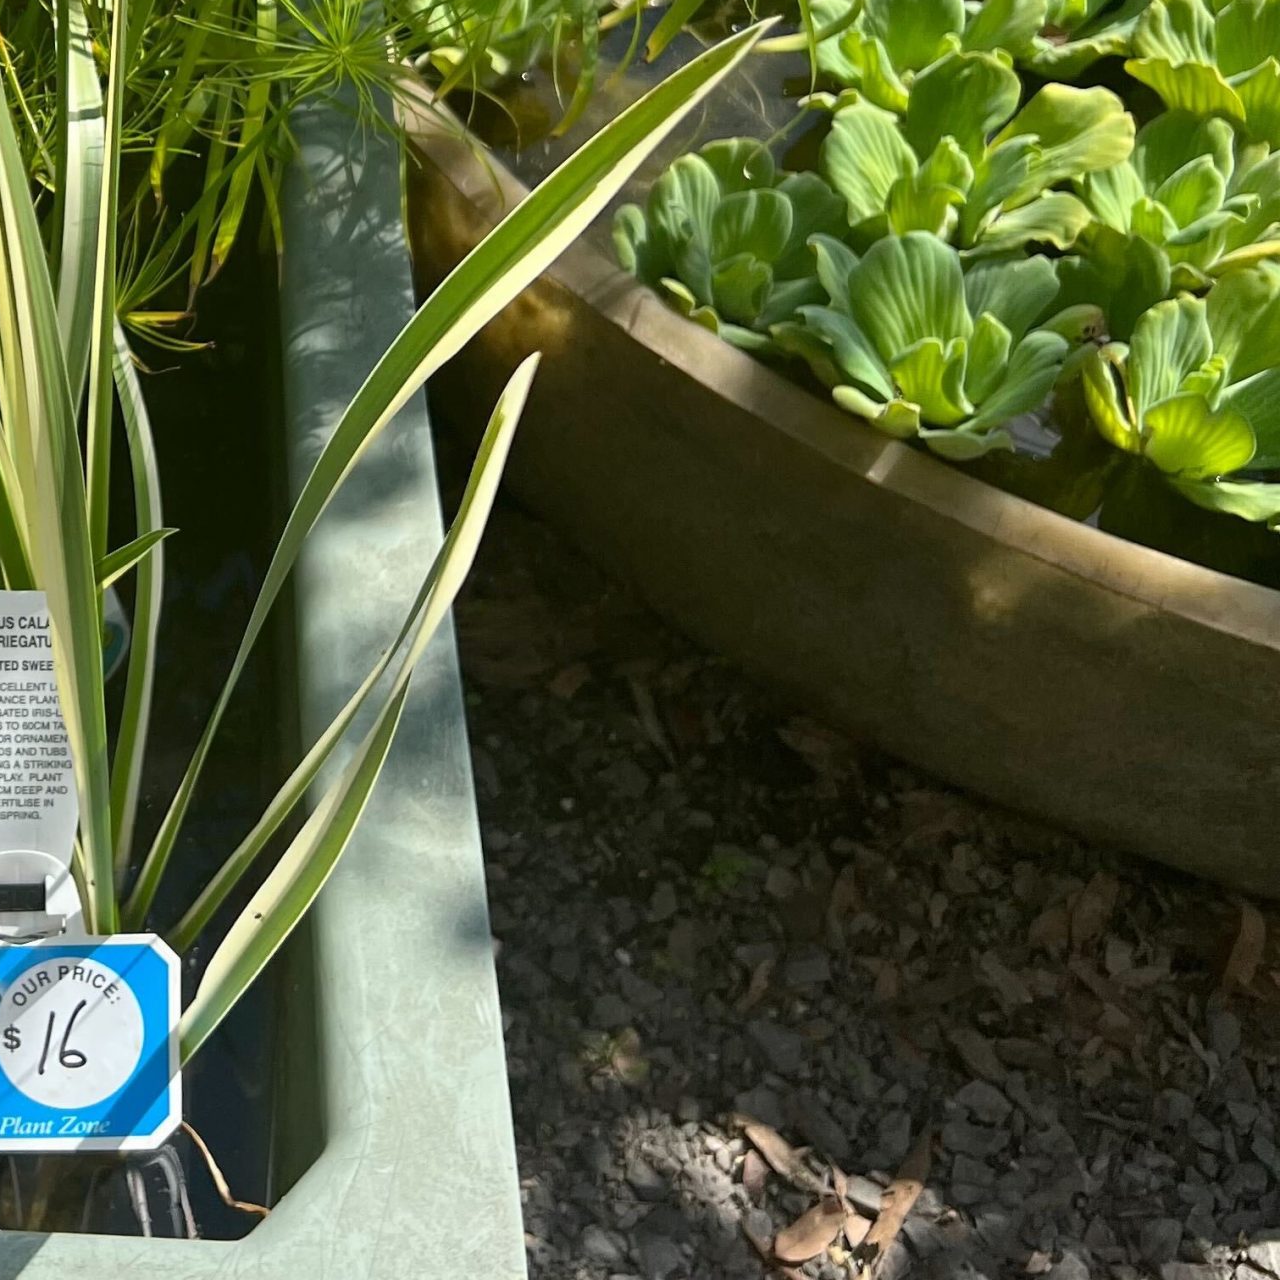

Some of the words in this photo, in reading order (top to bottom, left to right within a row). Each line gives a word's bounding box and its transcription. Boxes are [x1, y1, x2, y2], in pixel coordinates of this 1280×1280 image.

[17, 615, 50, 630] CALA
[21, 660, 54, 672] SWEE
[32, 708, 63, 718] IRIS-L
[6, 721, 19, 731] TO
[22, 721, 50, 731] 60CM
[14, 734, 68, 744] ORNAMEN
[15, 747, 37, 757] AND
[40, 747, 67, 756] TUBS
[23, 760, 73, 769] STRIKING
[29, 773, 63, 782] PLANT
[14, 786, 42, 795] DEEP
[45, 785, 69, 795] AND
[43, 798, 54, 808] IN
[0, 810, 43, 820] SPRING.
[12, 970, 52, 1007] OUR
[58, 965, 122, 1005] PRICE:
[3, 1023, 22, 1053] $
[38, 998, 88, 1075] 16
[58, 1116, 112, 1135] Zone
